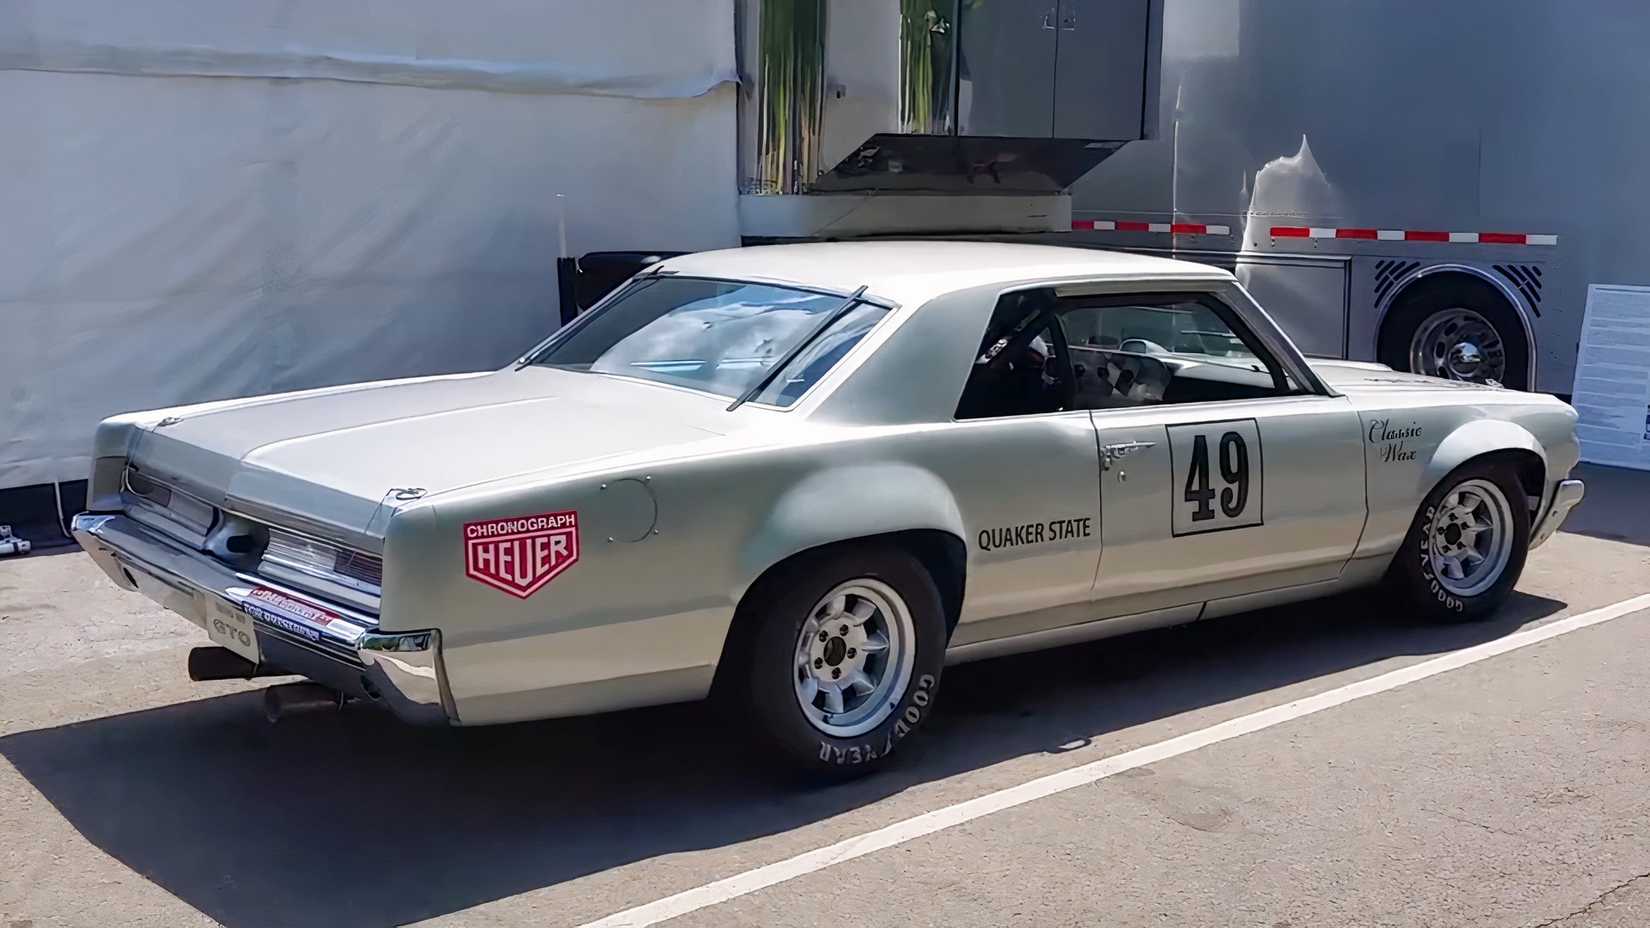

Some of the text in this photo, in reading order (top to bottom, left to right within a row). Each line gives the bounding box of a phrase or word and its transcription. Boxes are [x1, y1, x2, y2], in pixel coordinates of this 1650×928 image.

[1369, 418, 1422, 443] Classic
[1184, 431, 1249, 521] 49
[467, 514, 575, 538] CHRONOGRAPH
[978, 517, 1091, 551] QUAKER STATE
[477, 534, 569, 587] HEUER
[213, 618, 251, 647] GTO
